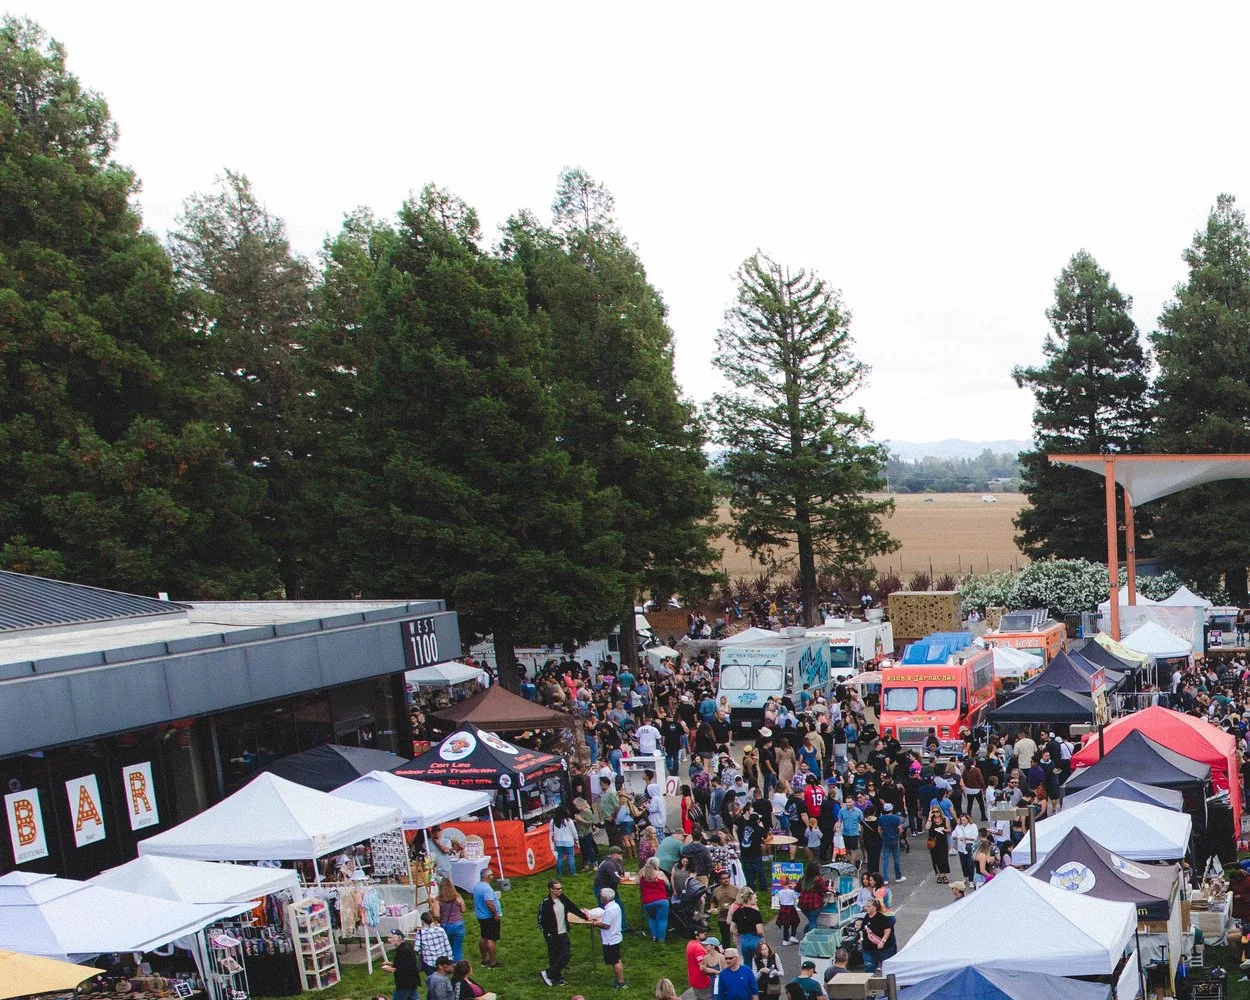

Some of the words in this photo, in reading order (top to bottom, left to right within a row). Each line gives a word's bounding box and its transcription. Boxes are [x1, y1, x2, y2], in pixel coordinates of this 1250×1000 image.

[409, 619, 434, 634] WEST
[411, 633, 438, 666] 1100
[811, 793, 823, 806] 19
